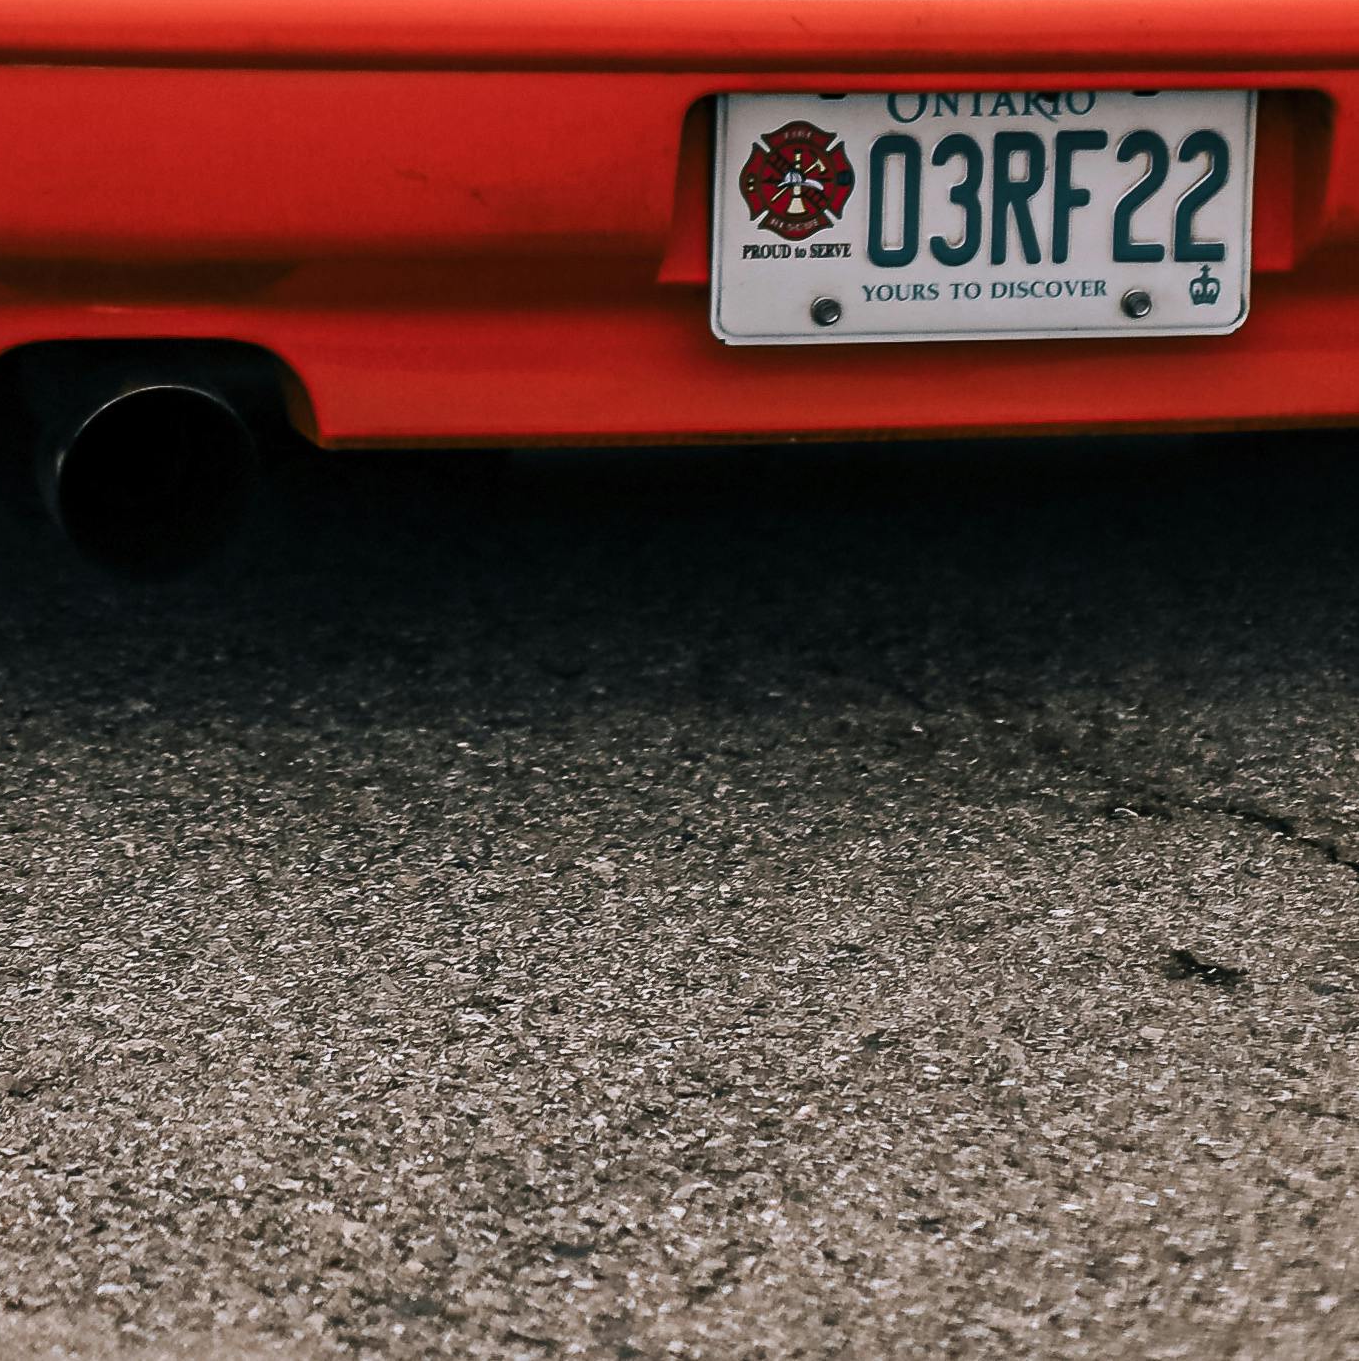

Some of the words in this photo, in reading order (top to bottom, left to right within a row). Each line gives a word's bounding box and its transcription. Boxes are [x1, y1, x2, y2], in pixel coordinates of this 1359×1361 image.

[868, 129, 1230, 267] 03RF22
[742, 244, 791, 260] PROUD
[809, 243, 852, 259] SERVE
[861, 284, 940, 302] YOURS
[949, 283, 982, 300] TO
[991, 280, 1108, 299] DISCOVER
